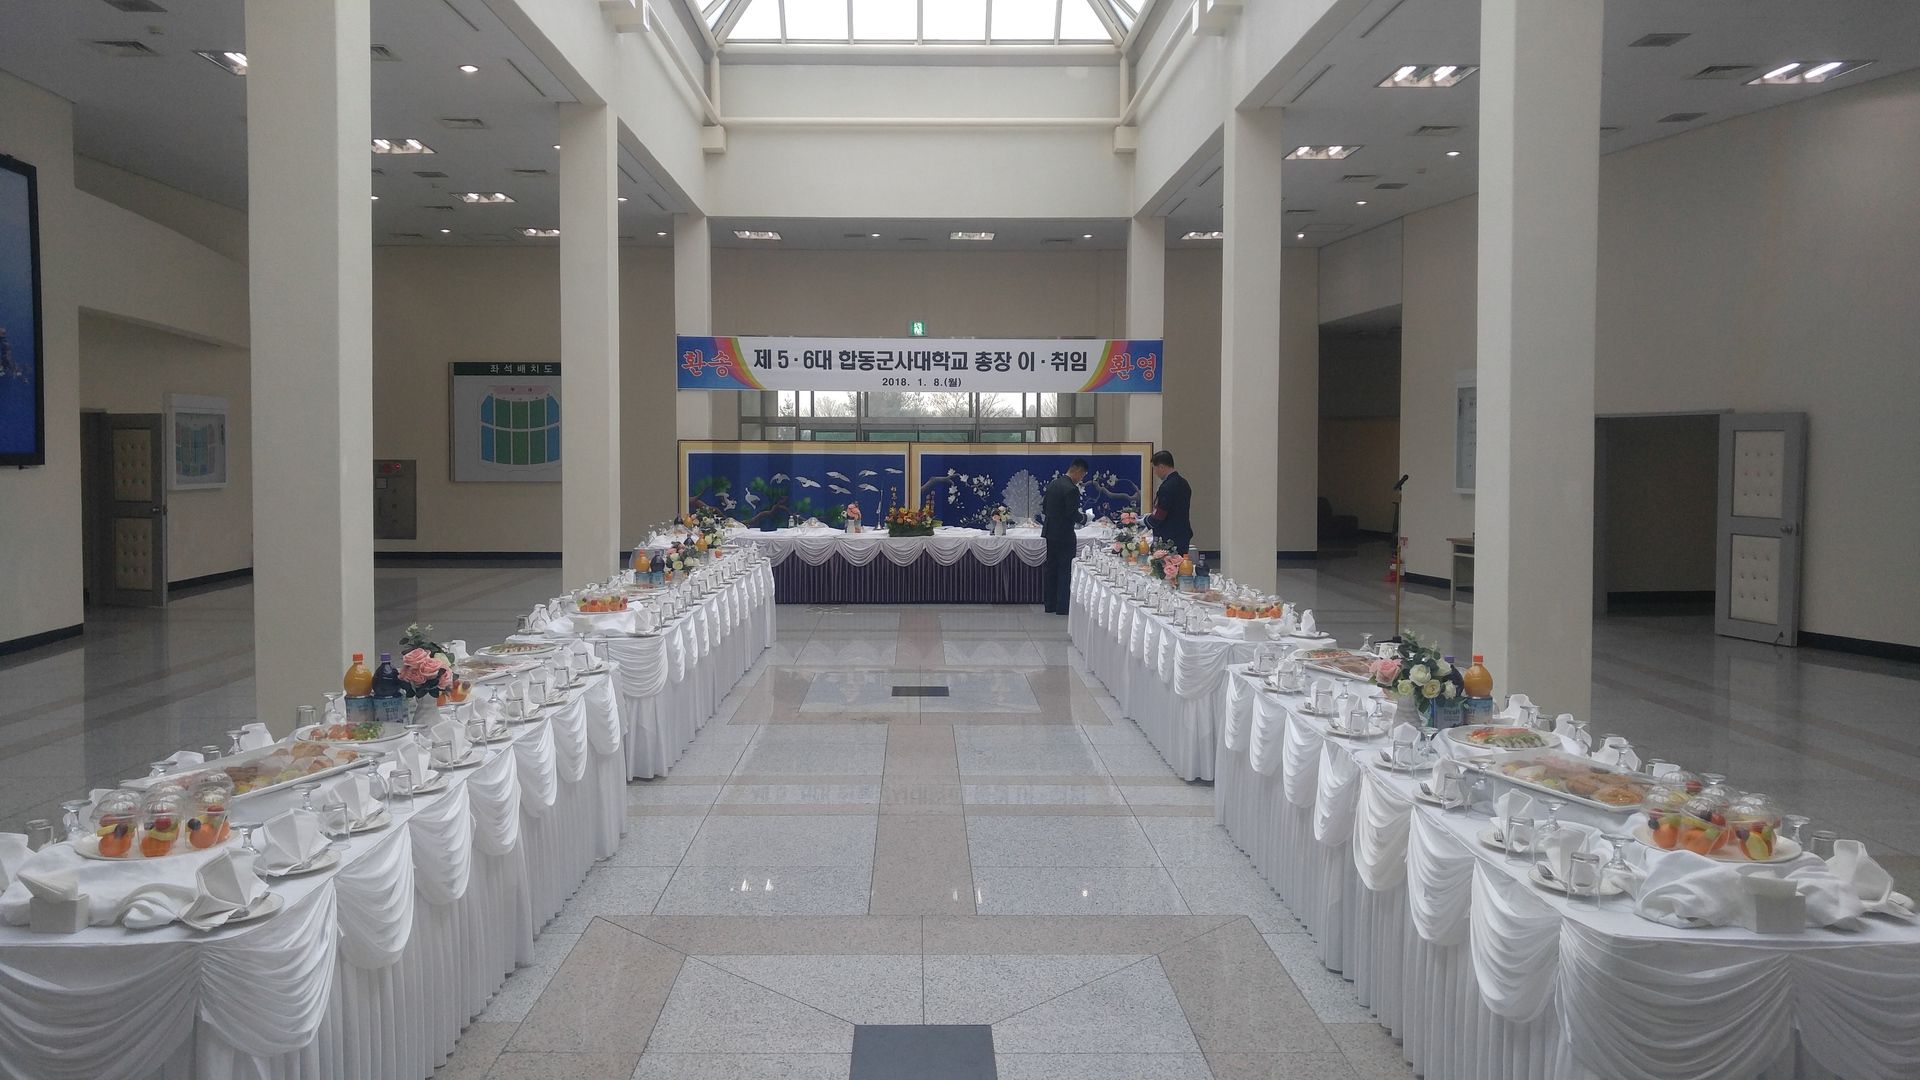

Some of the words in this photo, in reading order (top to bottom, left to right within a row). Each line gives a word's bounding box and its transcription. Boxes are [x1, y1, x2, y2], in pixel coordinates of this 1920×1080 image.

[682, 349, 732, 377] 환송
[753, 348, 772, 370] 제
[838, 350, 969, 371] 합동군사대학교
[974, 351, 1012, 372] 총장
[1017, 351, 1087, 372] 이·취임
[1109, 352, 1157, 380] 환영
[882, 377, 910, 387] 2018.
